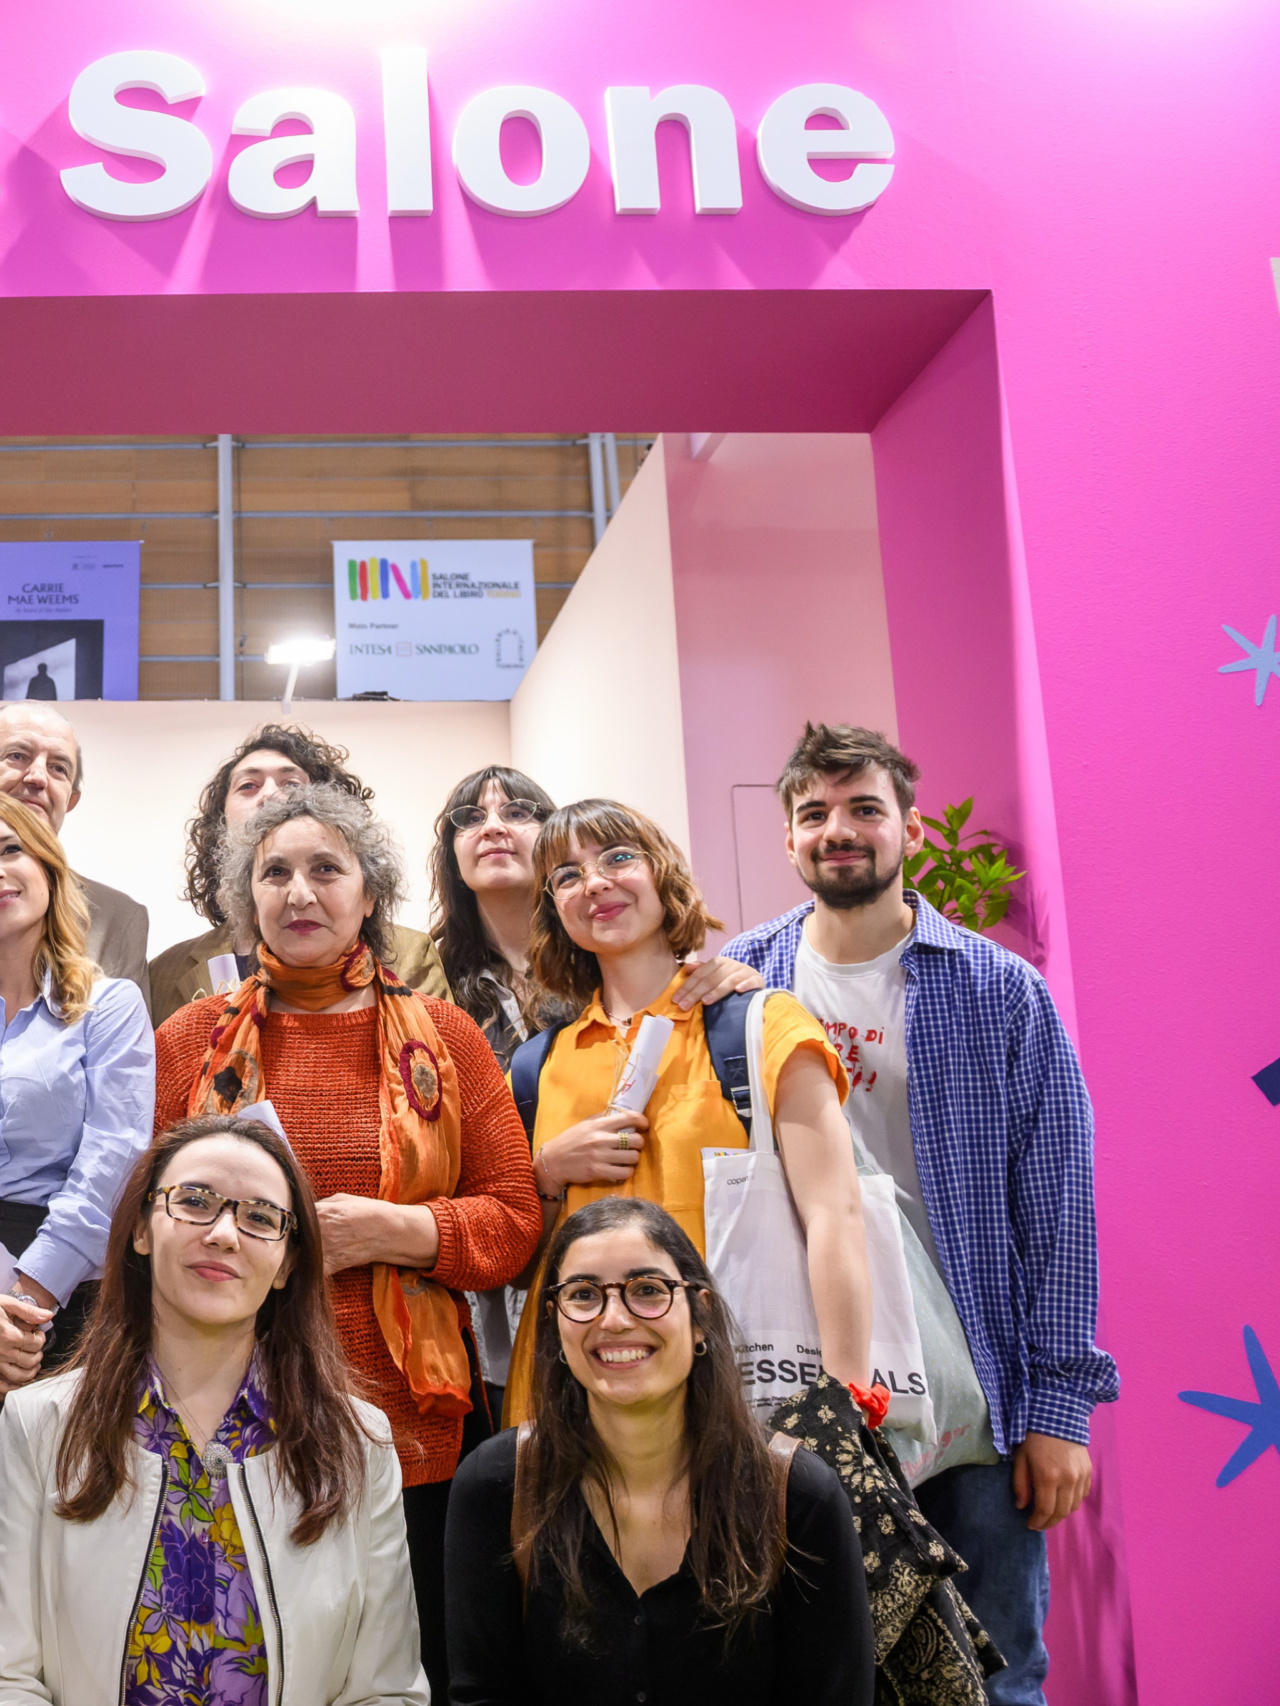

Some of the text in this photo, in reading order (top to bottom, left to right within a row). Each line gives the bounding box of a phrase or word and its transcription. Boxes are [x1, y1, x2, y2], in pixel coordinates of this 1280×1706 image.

[60, 46, 897, 223] Salone
[432, 573, 469, 581] SALONE
[22, 583, 65, 593] CARRIE
[8, 594, 80, 605] MAE WEEMS
[349, 644, 392, 655] INTESA
